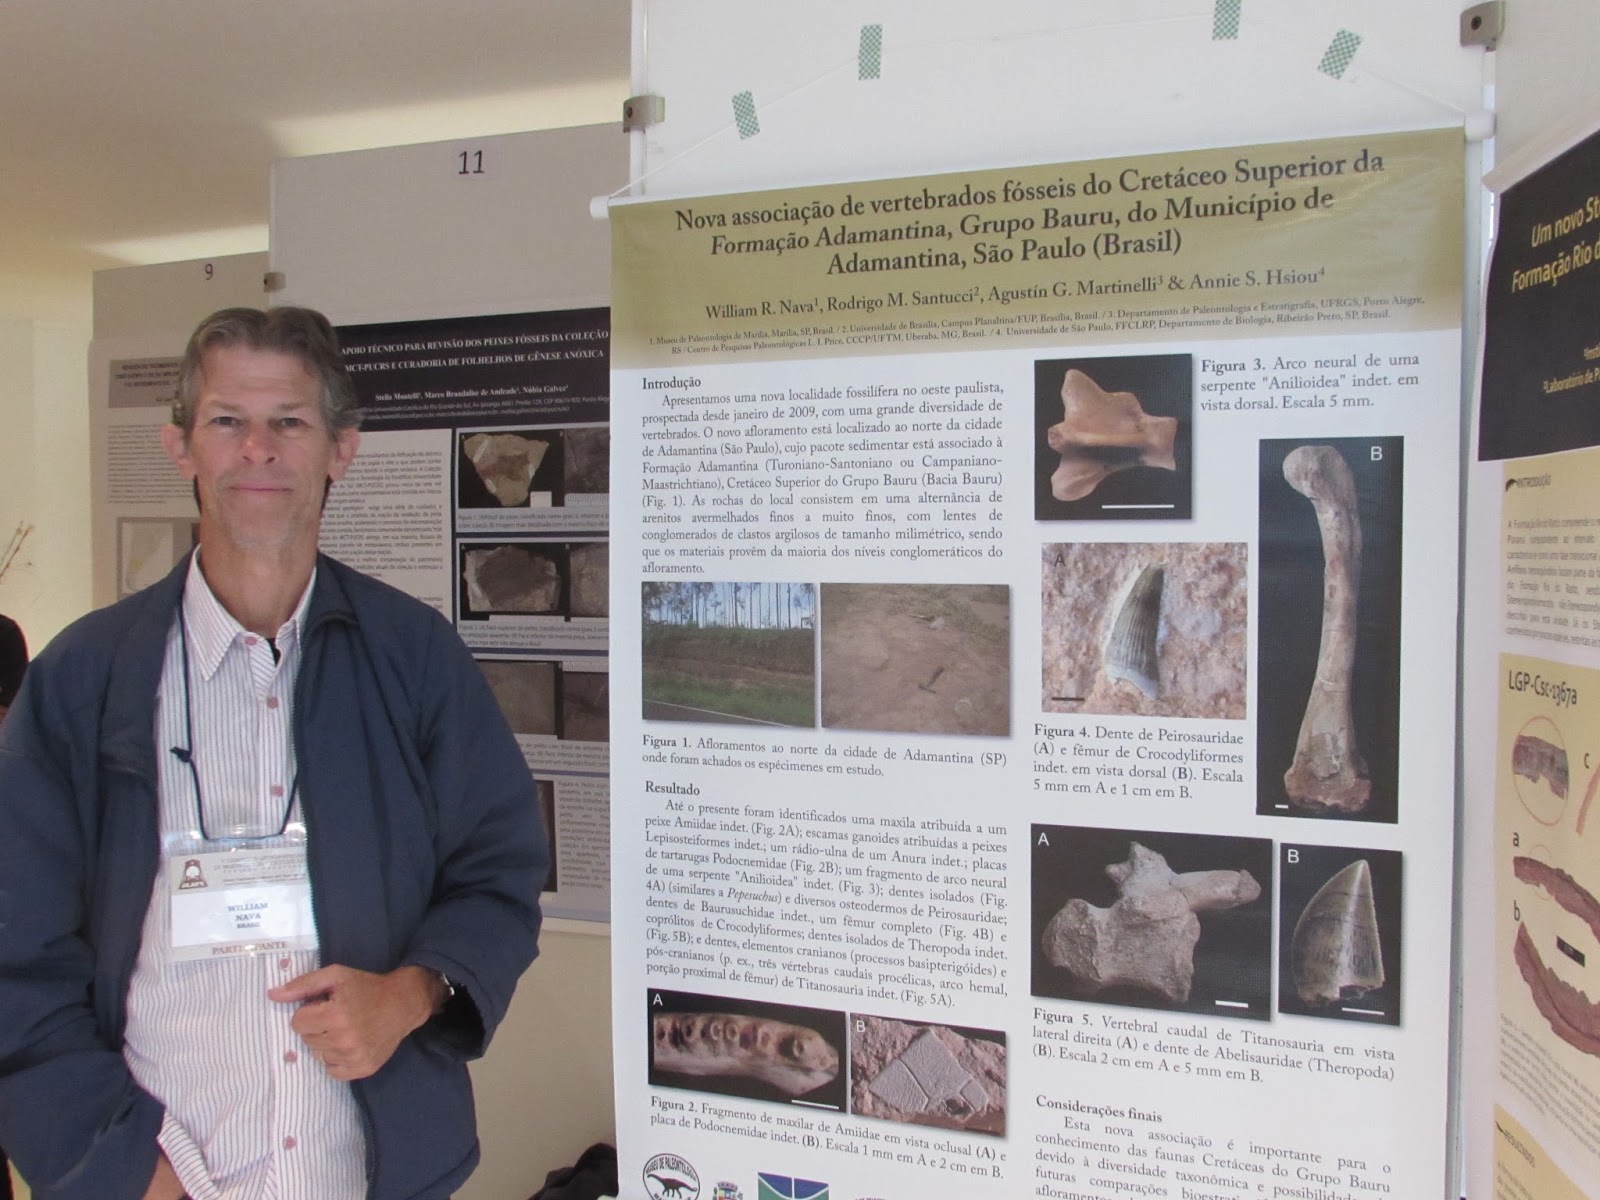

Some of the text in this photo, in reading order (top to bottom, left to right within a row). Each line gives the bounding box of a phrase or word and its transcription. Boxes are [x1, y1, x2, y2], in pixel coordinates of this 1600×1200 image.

[458, 150, 485, 175] 11
[675, 150, 1384, 230] Nova associação de vertebrados fósseis do Cretáceo Superior da
[710, 188, 1333, 256] Formação Adamantina, Grupo Bauru, do Município de
[1531, 195, 1600, 248] Um novo St
[826, 229, 1181, 275] Adamantina, São Paulo (Brasil)
[204, 263, 213, 281] 9
[1511, 251, 1572, 293] Formação
[1573, 240, 1592, 270] Rio
[705, 300, 757, 319] William
[761, 298, 776, 316] R.
[827, 292, 883, 314] Rodrigo
[887, 290, 908, 308] M.
[988, 281, 1048, 305] Agustín
[1052, 280, 1072, 297] G.
[1167, 273, 1184, 291] &
[1188, 270, 1240, 290] Annie
[1245, 269, 1260, 286] S.
[368, 343, 403, 354] TÉCNICO
[405, 342, 426, 352] PARA
[427, 338, 463, 350] REVISÃO
[465, 338, 482, 347] DOS
[484, 336, 514, 346] PEIXES
[515, 334, 550, 344] FÓSSEIS
[551, 333, 563, 342] DA
[564, 329, 609, 341] COLEÇÃO
[391, 361, 397, 370] E
[398, 359, 447, 369] CURADORIA
[448, 358, 460, 366] DE
[461, 354, 513, 366] FOLHELHOS
[514, 354, 526, 363] DE
[527, 350, 562, 361] GÊNESE
[564, 348, 604, 360] ANÓXICA
[1201, 353, 1419, 376] Figura 3. Arco neural de uma
[642, 375, 701, 391] Introdução
[662, 380, 1003, 409] Apresentamos uma nova localidade fossilífera no oeste paulista,
[1200, 373, 1418, 395] serpente "Anilioidea" indet. em
[1200, 394, 1374, 411] vista dorsal. Escala 5 mm.
[1370, 446, 1383, 461] B
[642, 508, 1002, 523] arenitos avermelhados finos a muito finos, com lentes de
[1054, 553, 1066, 567] A
[1034, 723, 1243, 744] Figura 4. Dente de Peirosauridae
[642, 733, 1006, 769] Figura 1. Afloramentos ao norte da cidade de Adamantina (SP)
[645, 781, 700, 795] Resultado
[1037, 832, 1299, 864] A B
[1512, 832, 1520, 848] a
[227, 902, 268, 912] WILLIAM
[235, 913, 262, 922] NAVA
[1513, 900, 1521, 922] b
[212, 941, 288, 955] PARTIPANTE
[645, 913, 1007, 960] coprólitos de Crocodyliformes; dentes isolados de Theropoda indet.
[653, 993, 866, 1033] A B
[1033, 1007, 1394, 1060] Figura 5. Vertebral caudal de Titanosauria em vista
[1035, 1095, 1162, 1123] Considerações finais
